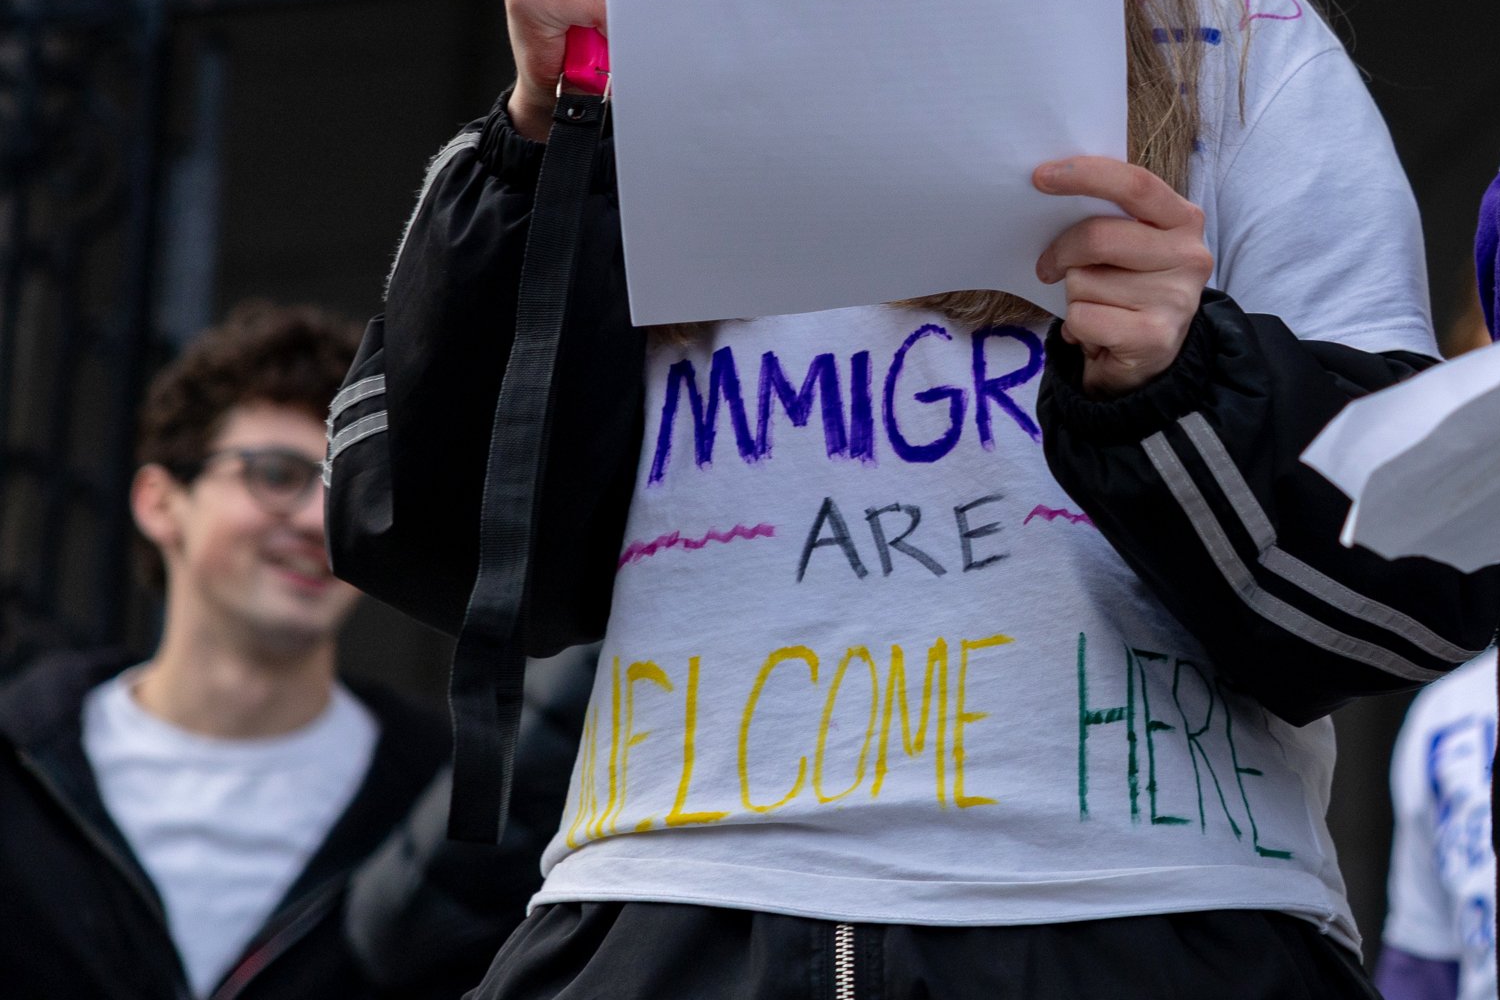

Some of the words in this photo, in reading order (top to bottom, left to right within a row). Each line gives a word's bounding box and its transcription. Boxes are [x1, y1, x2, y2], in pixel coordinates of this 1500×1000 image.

[647, 322, 1044, 489] MMIGR
[797, 495, 1008, 583] ARE
[1076, 632, 1293, 860] HERE
